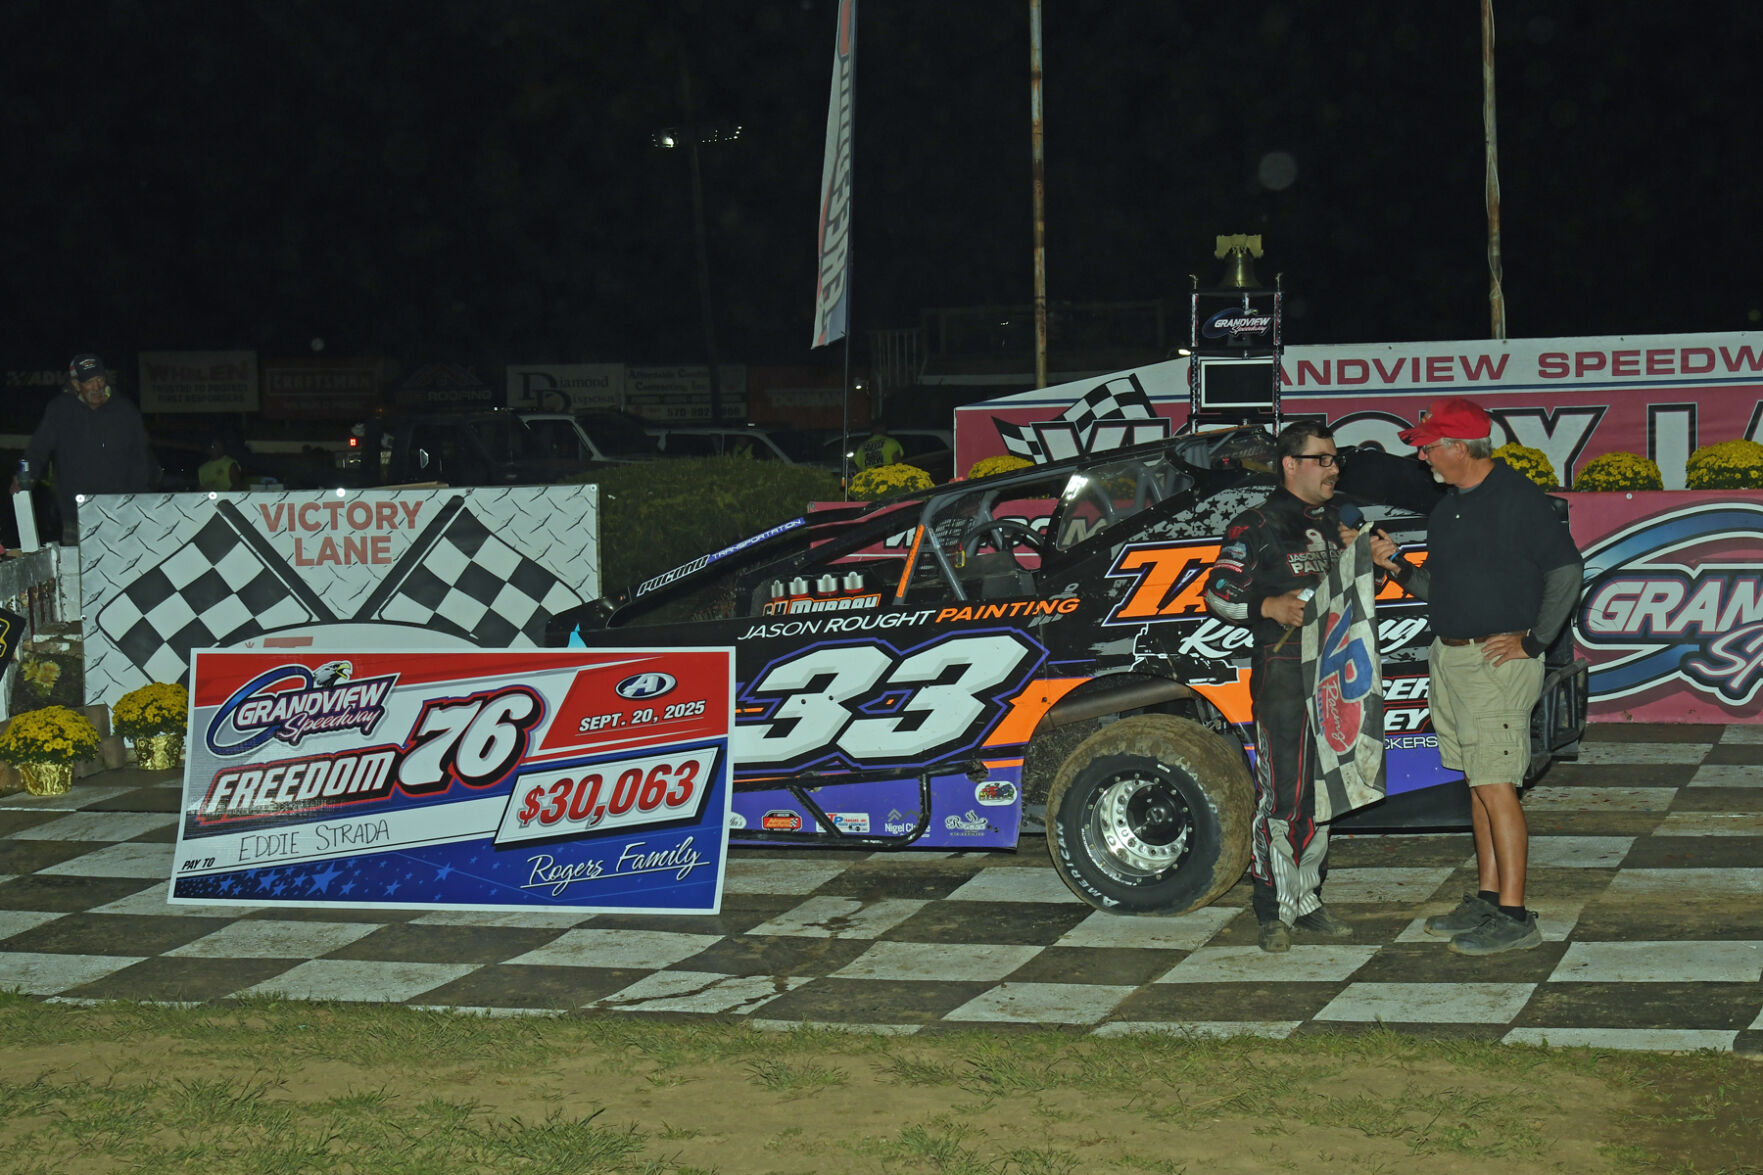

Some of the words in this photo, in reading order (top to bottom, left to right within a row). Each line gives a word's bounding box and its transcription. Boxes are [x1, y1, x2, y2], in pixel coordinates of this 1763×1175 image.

[1214, 317, 1271, 328] GRANDVIEW
[1187, 352, 1510, 388] NDVIEW
[259, 501, 424, 532] VICTORY
[294, 535, 393, 566] LANE
[737, 618, 824, 640] JASON
[824, 610, 937, 634] ROUGHT
[936, 598, 1081, 624] PAINTING
[236, 682, 389, 726] GRANDVIEW
[579, 712, 627, 732] SEPT.
[632, 707, 659, 724] 20,
[663, 700, 706, 720] 2025
[734, 635, 1030, 764] 33
[277, 705, 382, 742] Speedway
[205, 750, 396, 813] FREEDOM
[399, 692, 534, 786] 76
[519, 759, 700, 826] $30,063
[239, 831, 300, 862] EDDIE
[315, 819, 390, 851] STRADA
[885, 822, 905, 834] Nigel
[182, 858, 201, 870] PAY
[202, 857, 215, 868] TO
[527, 854, 605, 896] Rogers
[616, 836, 703, 880] Family
